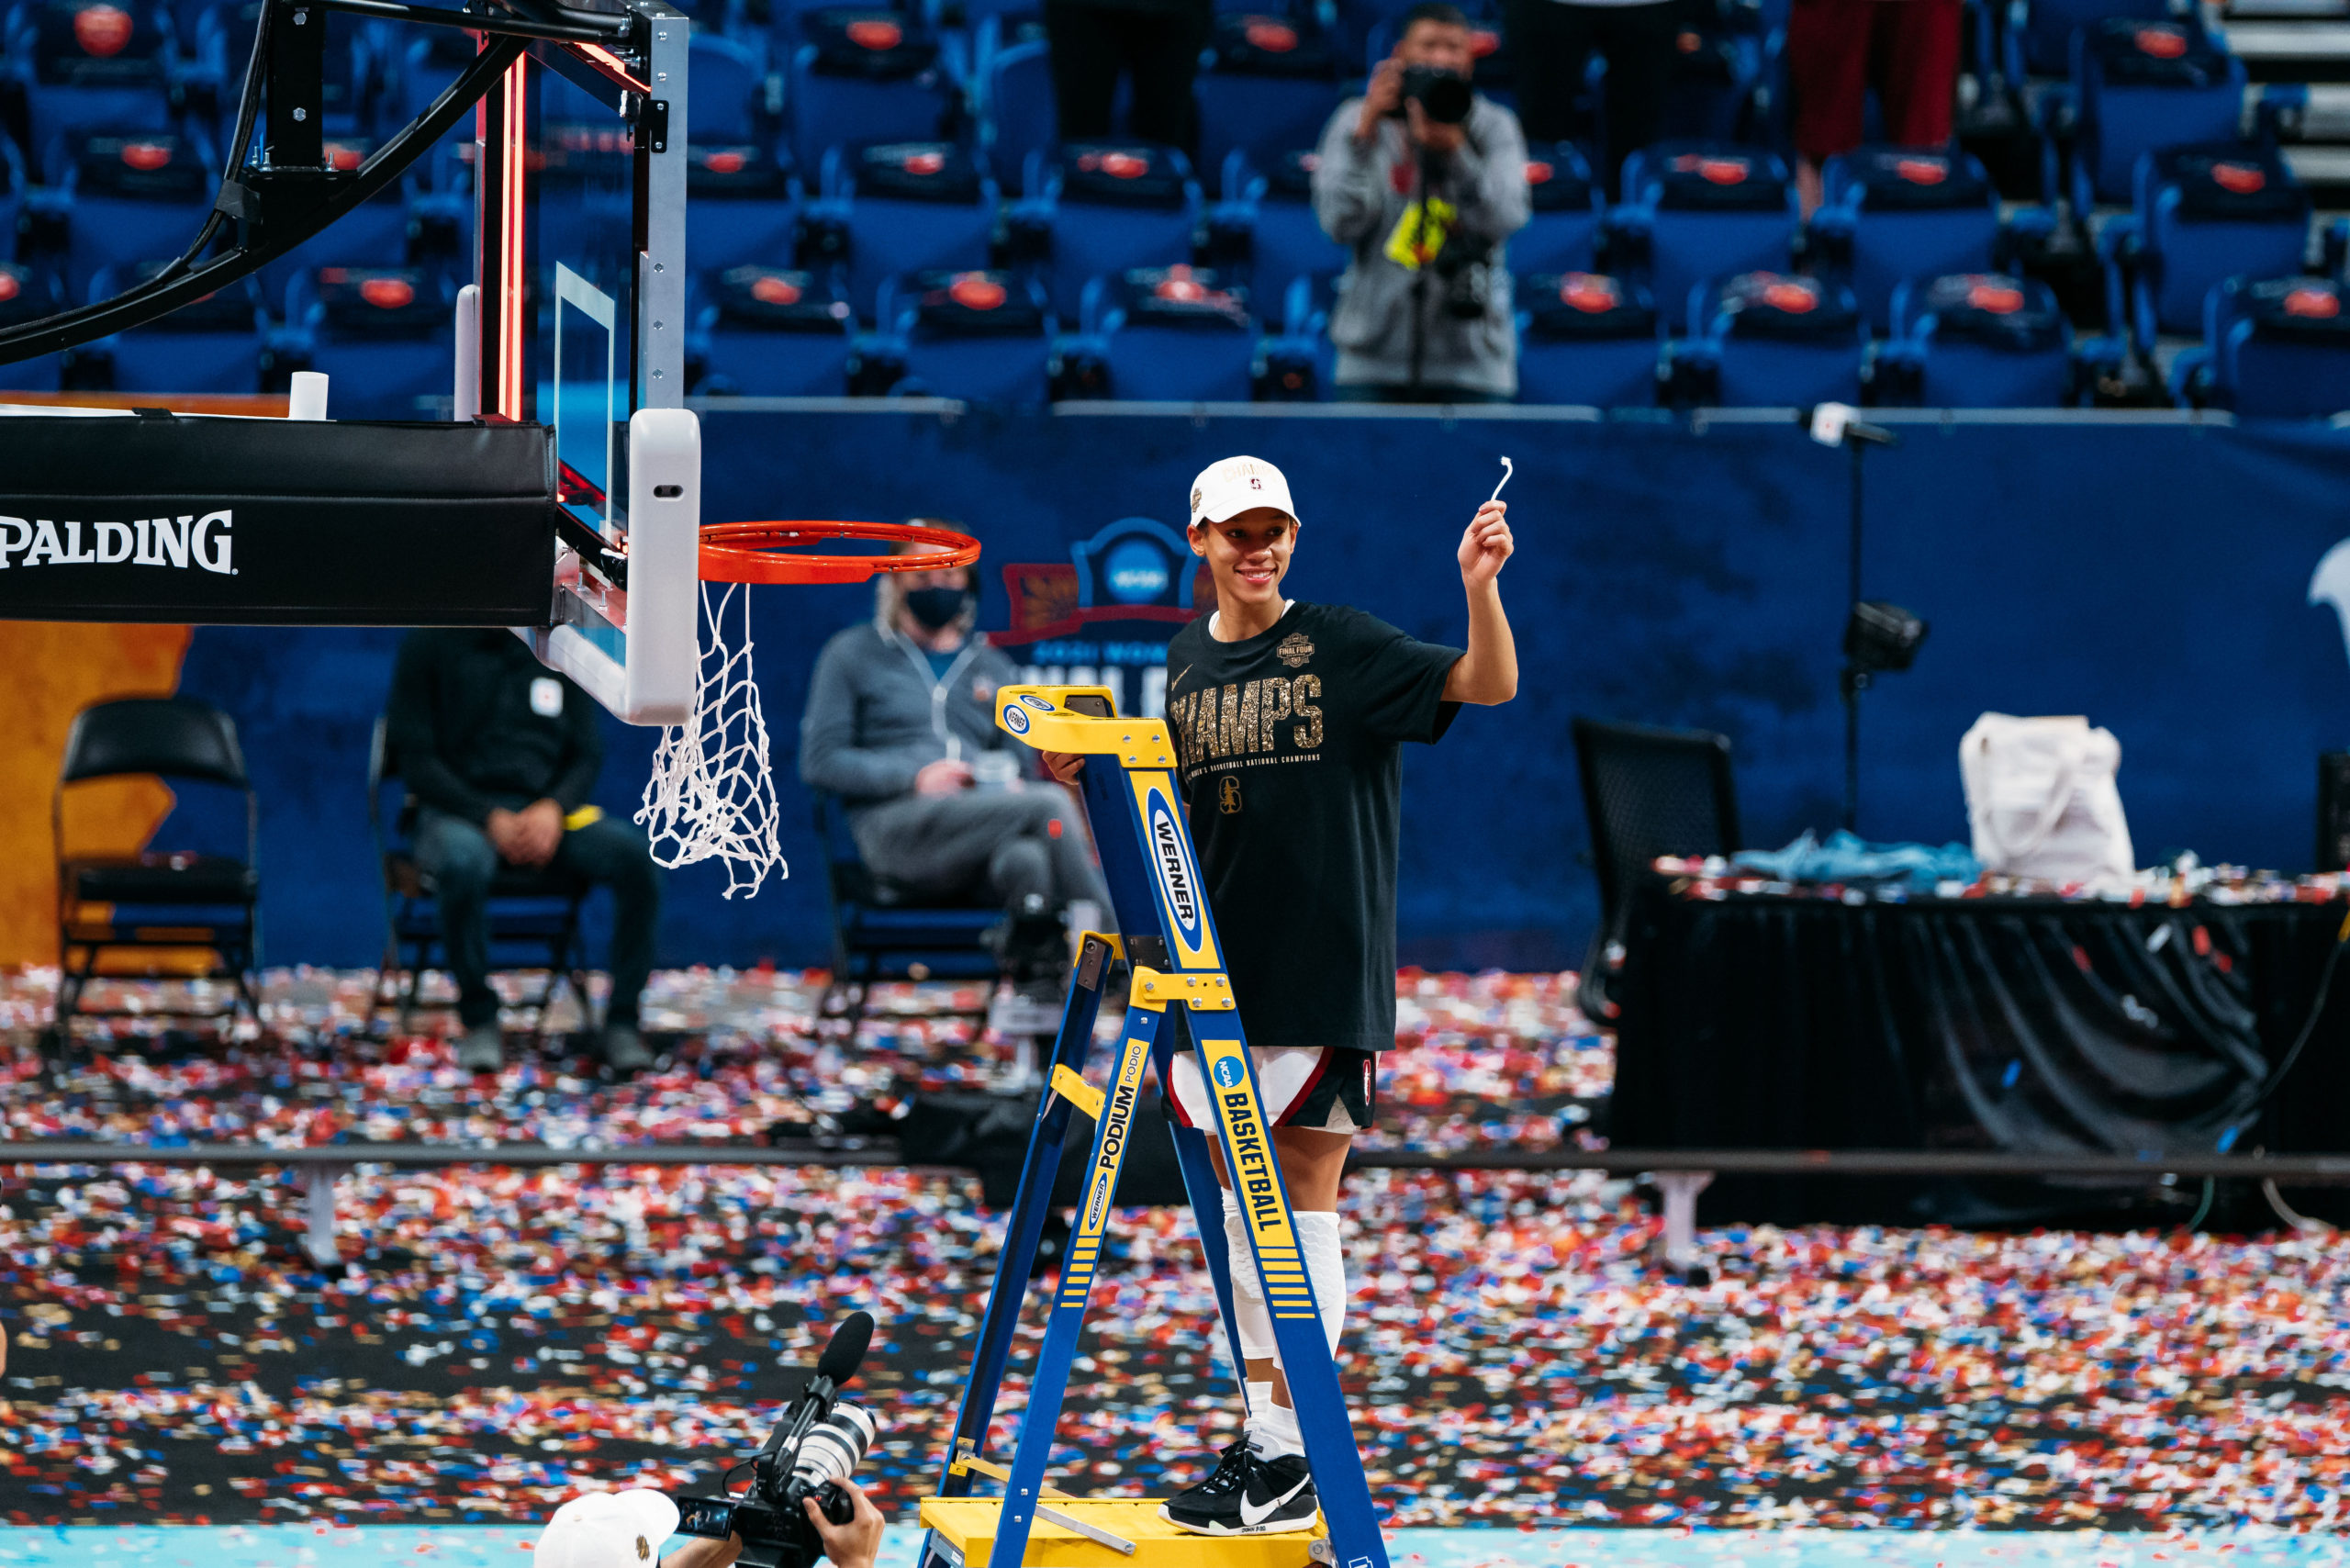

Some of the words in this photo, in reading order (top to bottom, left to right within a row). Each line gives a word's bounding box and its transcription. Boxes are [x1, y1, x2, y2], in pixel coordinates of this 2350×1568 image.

[1279, 647, 1295, 655] FINAL
[1296, 645, 1313, 654] FOUR
[1008, 710, 1026, 730] WERNER
[1170, 674, 1323, 773] HAMPS
[1210, 761, 1243, 772] BASKETBALL
[1246, 757, 1278, 767] NATIONAL
[1281, 754, 1321, 764] CHAMPIONS
[1157, 822, 1193, 920] WERNER
[1218, 1060, 1233, 1089] NCAA
[1091, 1183, 1105, 1220] WERNER
[1100, 1085, 1135, 1170] PODIUM
[1125, 1046, 1141, 1083] PODIO
[1224, 1092, 1281, 1232] BASKETBALL
